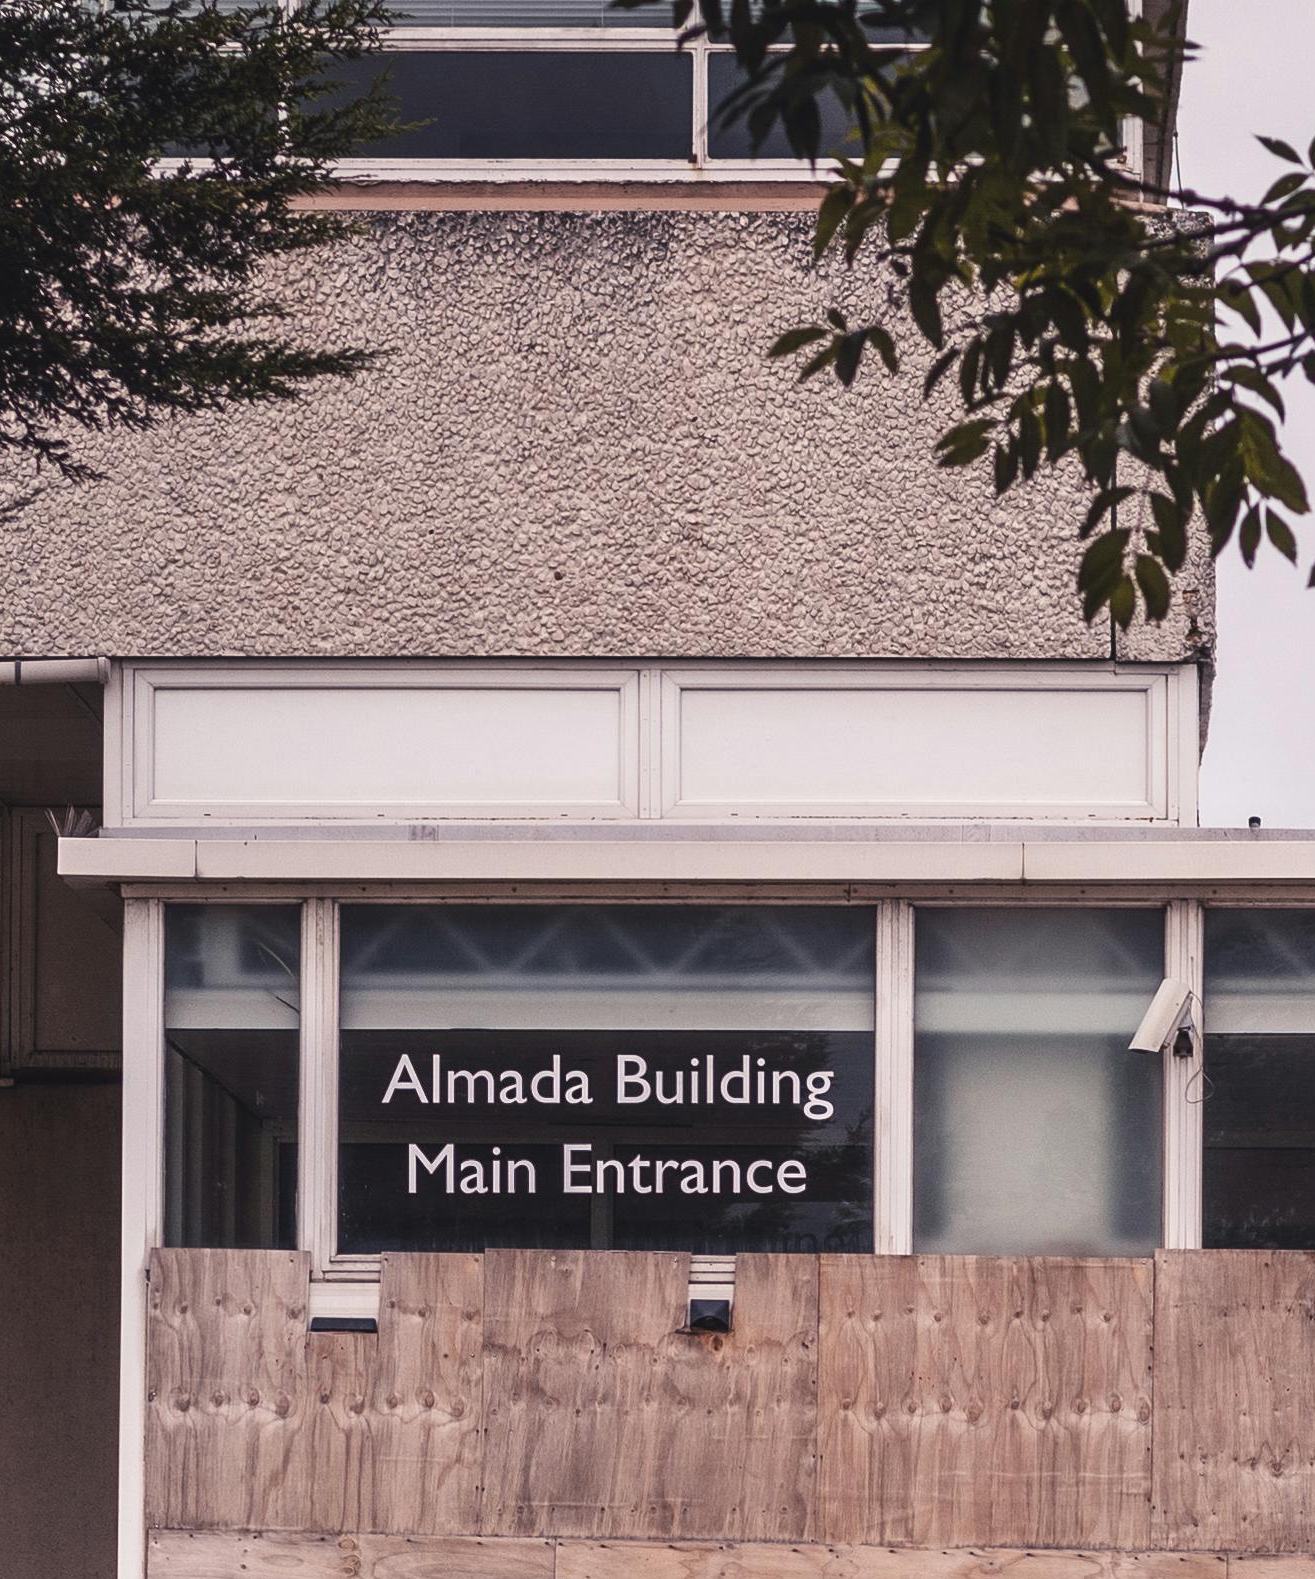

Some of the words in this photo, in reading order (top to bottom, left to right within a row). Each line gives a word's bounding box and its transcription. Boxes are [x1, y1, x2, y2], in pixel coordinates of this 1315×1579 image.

[381, 1053, 594, 1104] Almada
[616, 1053, 835, 1121] Building
[408, 1143, 536, 1194] Main
[563, 1143, 807, 1194] Entrance
